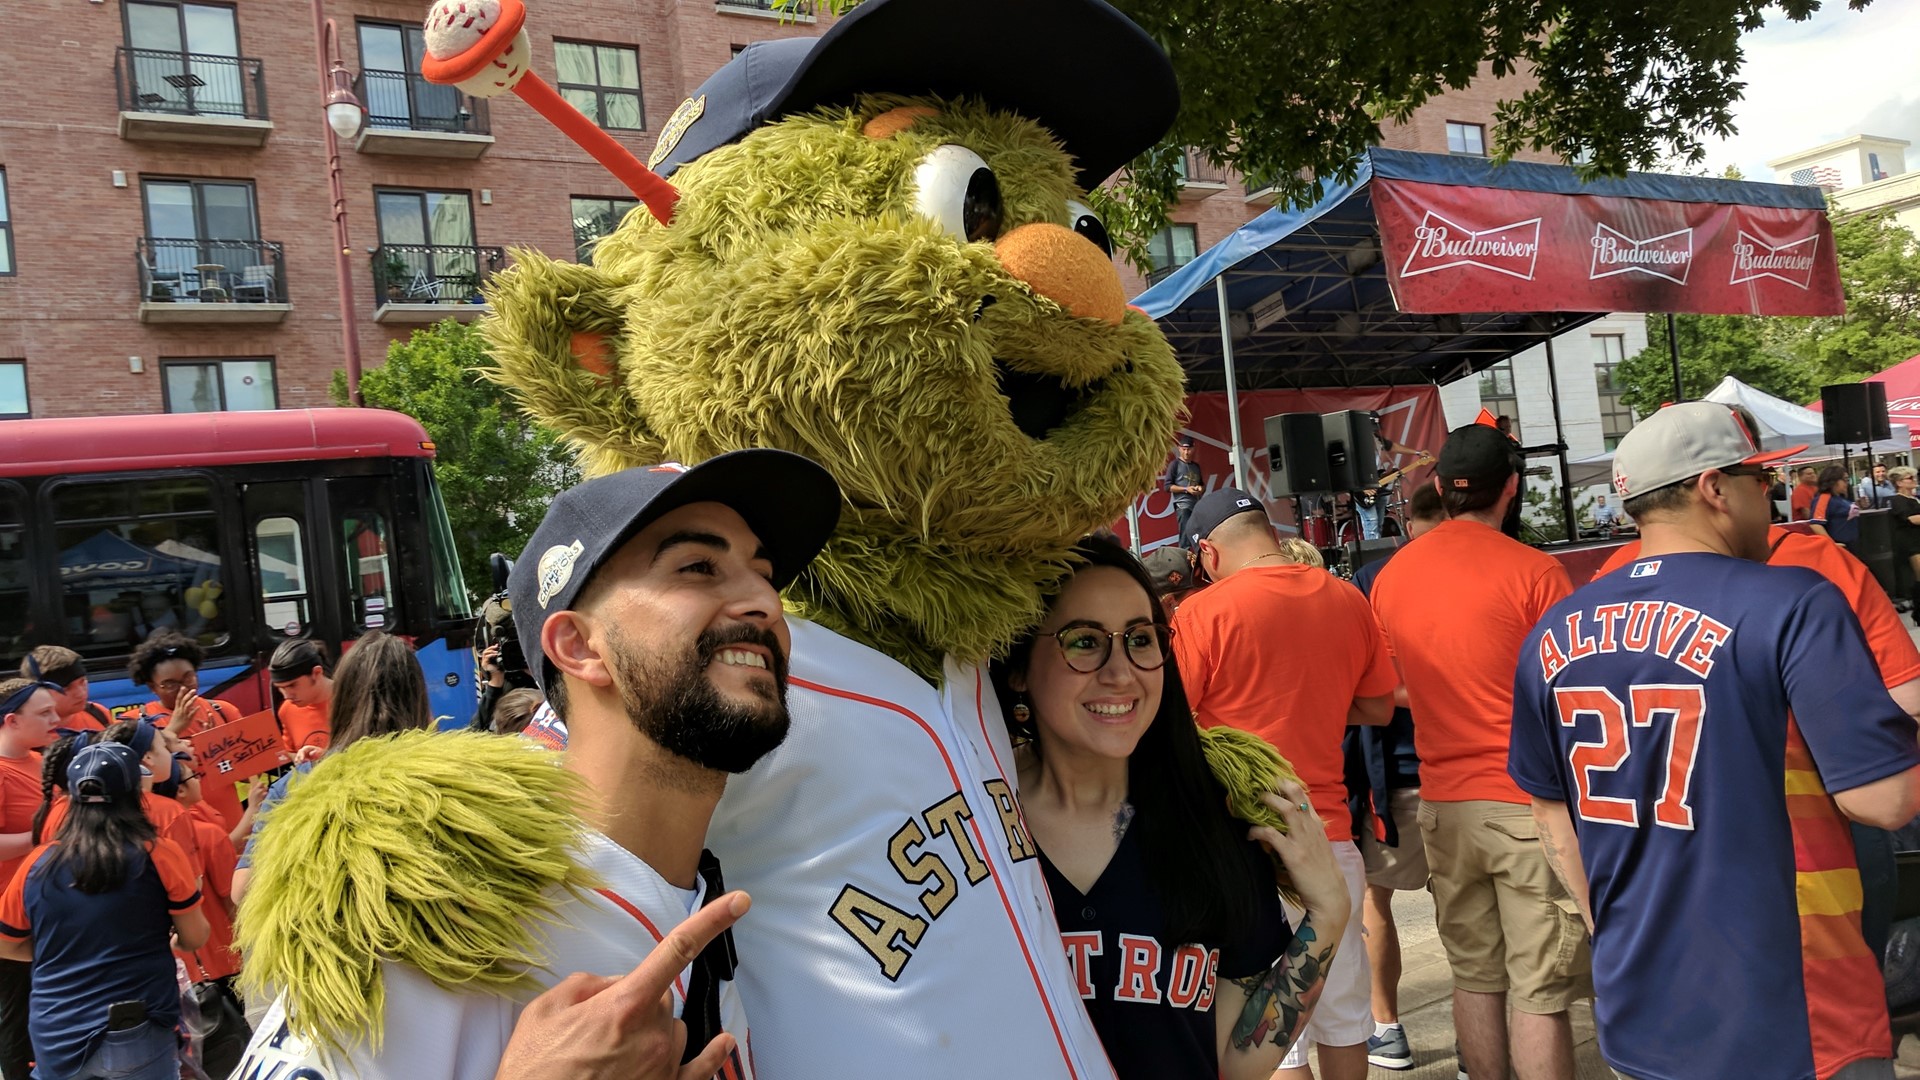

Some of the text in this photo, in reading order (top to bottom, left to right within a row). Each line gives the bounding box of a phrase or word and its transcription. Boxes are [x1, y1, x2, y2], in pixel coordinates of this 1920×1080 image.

[1415, 225, 1536, 258] Budweiser
[1591, 236, 1691, 265] Budweiser
[1733, 243, 1813, 270] Budweiser
[540, 545, 580, 603] CHAMPIONS
[1539, 600, 1733, 684] ALTUVE
[202, 731, 250, 761] NEVER
[233, 734, 278, 763] SETTLE
[1553, 684, 1706, 831] 27
[828, 778, 1037, 982] ASTR
[1060, 930, 1220, 1012] TROS
